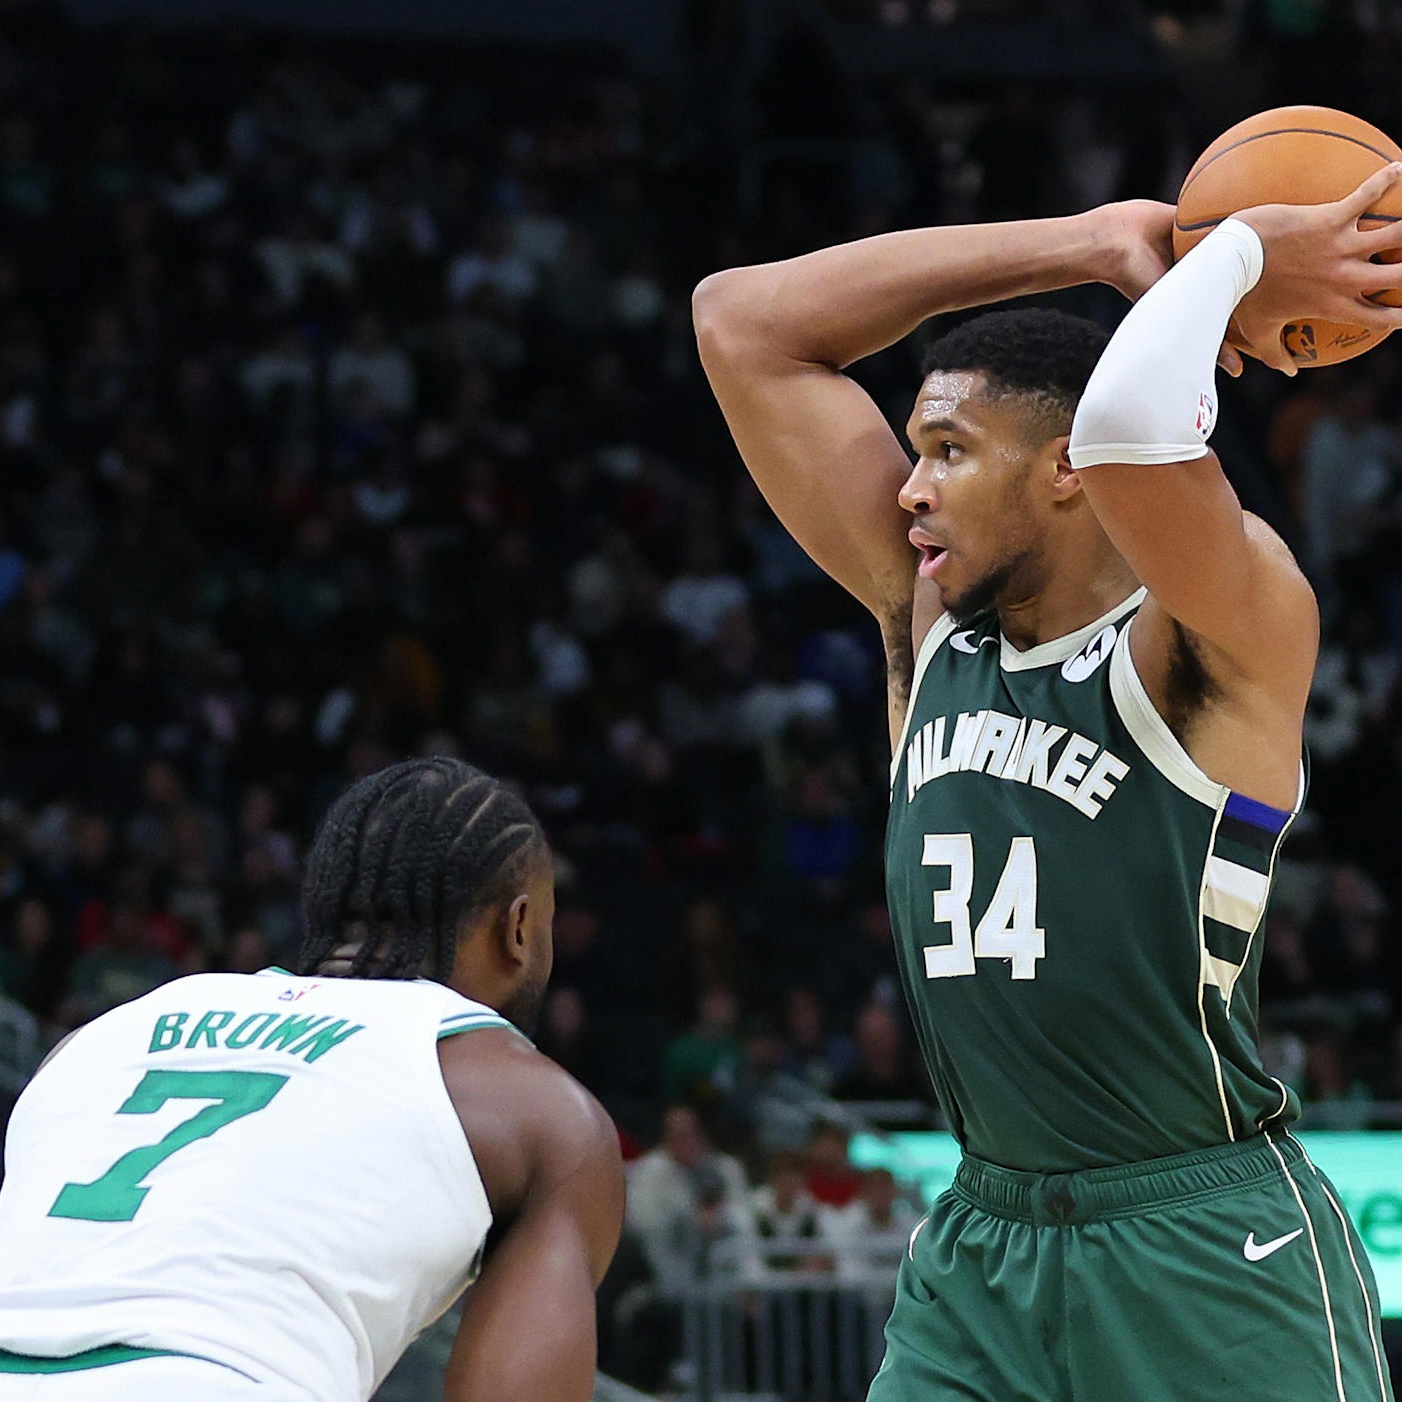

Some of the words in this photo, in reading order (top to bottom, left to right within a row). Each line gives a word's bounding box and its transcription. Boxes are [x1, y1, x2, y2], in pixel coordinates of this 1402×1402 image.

[921, 833, 1046, 981] 34
[148, 1010, 366, 1064] BROWN
[46, 1069, 290, 1222] 7
